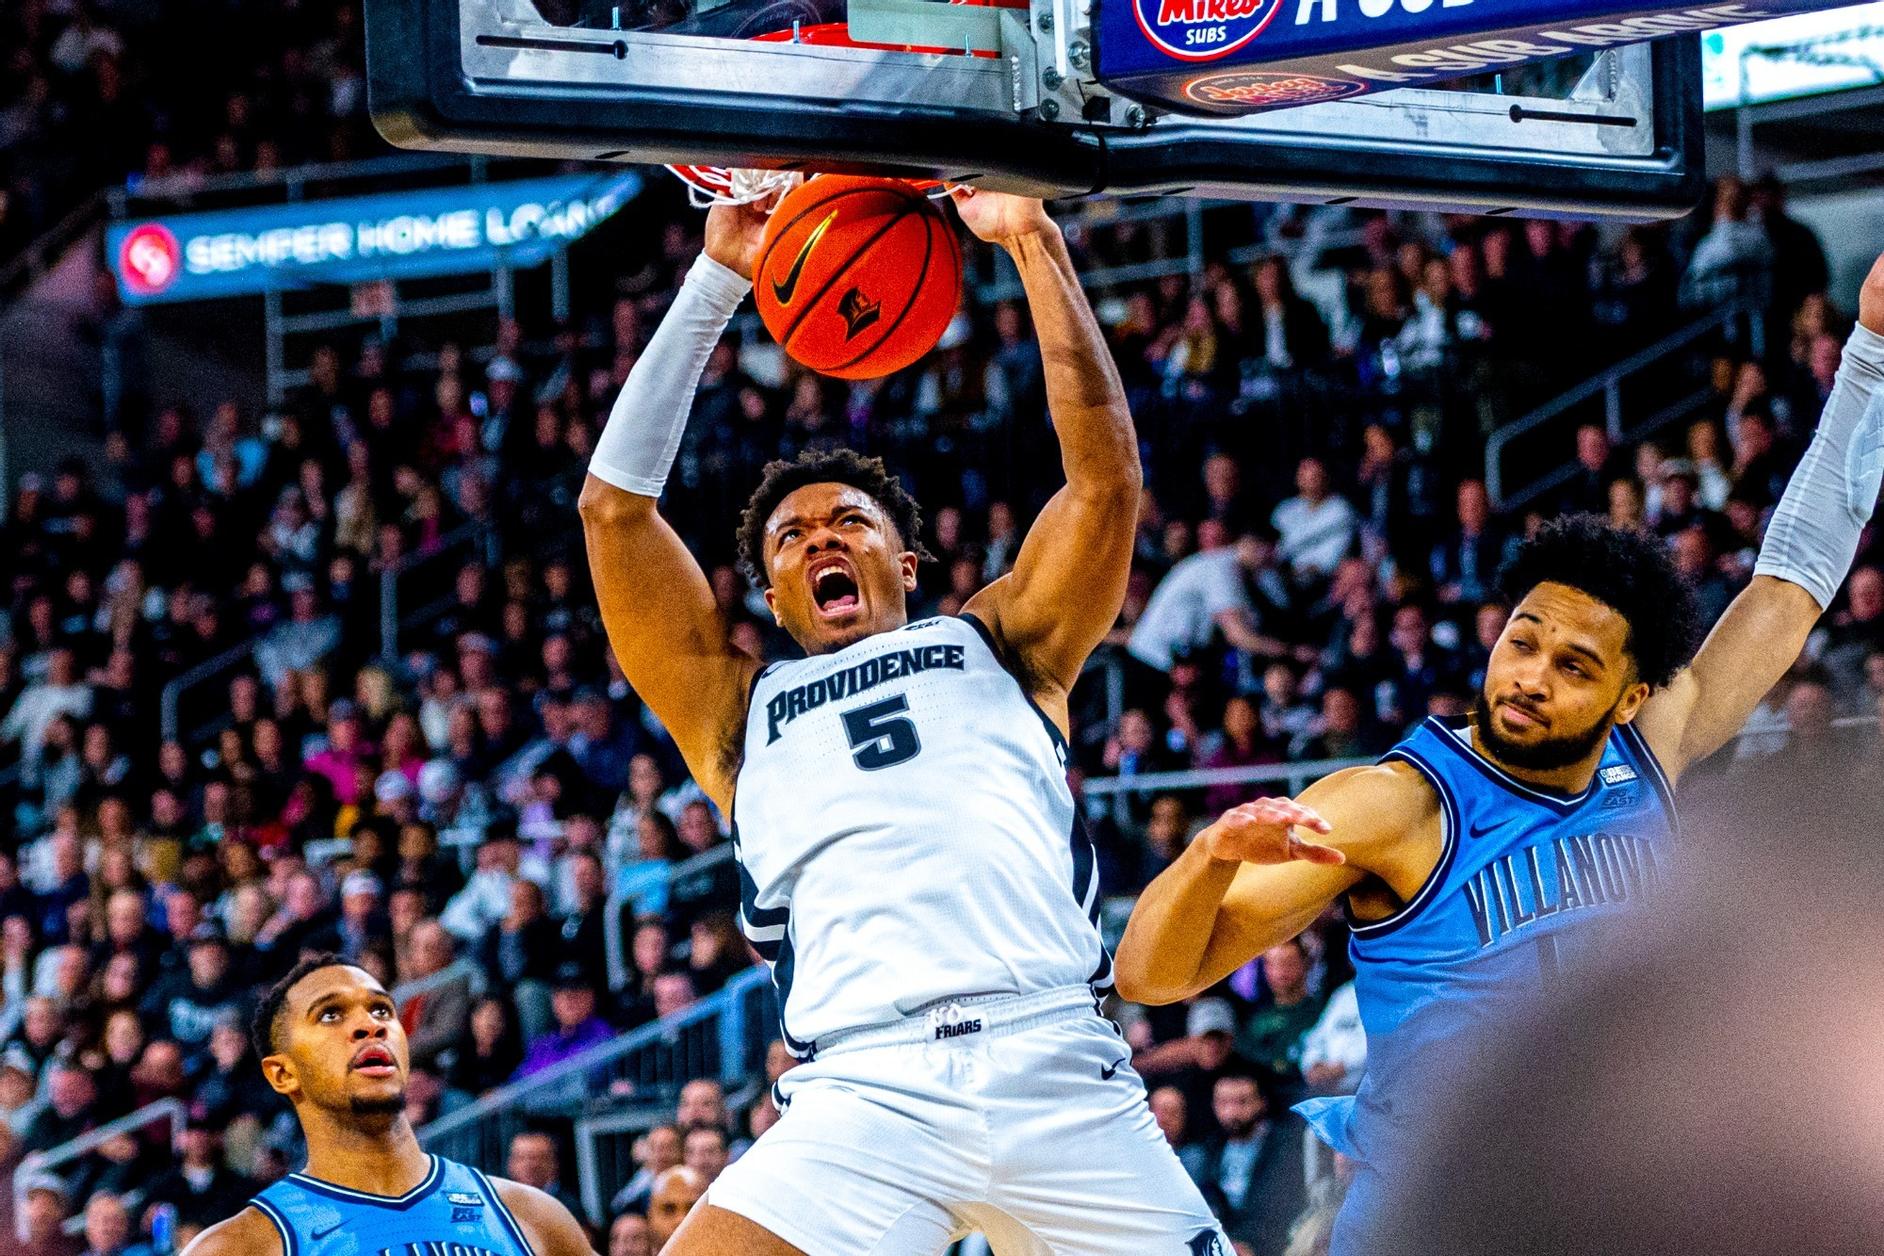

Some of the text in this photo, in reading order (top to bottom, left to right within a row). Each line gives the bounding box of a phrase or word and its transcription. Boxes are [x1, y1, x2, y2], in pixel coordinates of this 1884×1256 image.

[1185, 26, 1227, 45] SUBS
[1336, 64, 1437, 82] A
[1391, 39, 1573, 70] SUB
[186, 222, 354, 274] SEMPER
[357, 210, 481, 256] HOME
[765, 645, 965, 747] PROVIDENCE
[839, 693, 922, 771] 5
[935, 1019, 982, 1040] FRIARS
